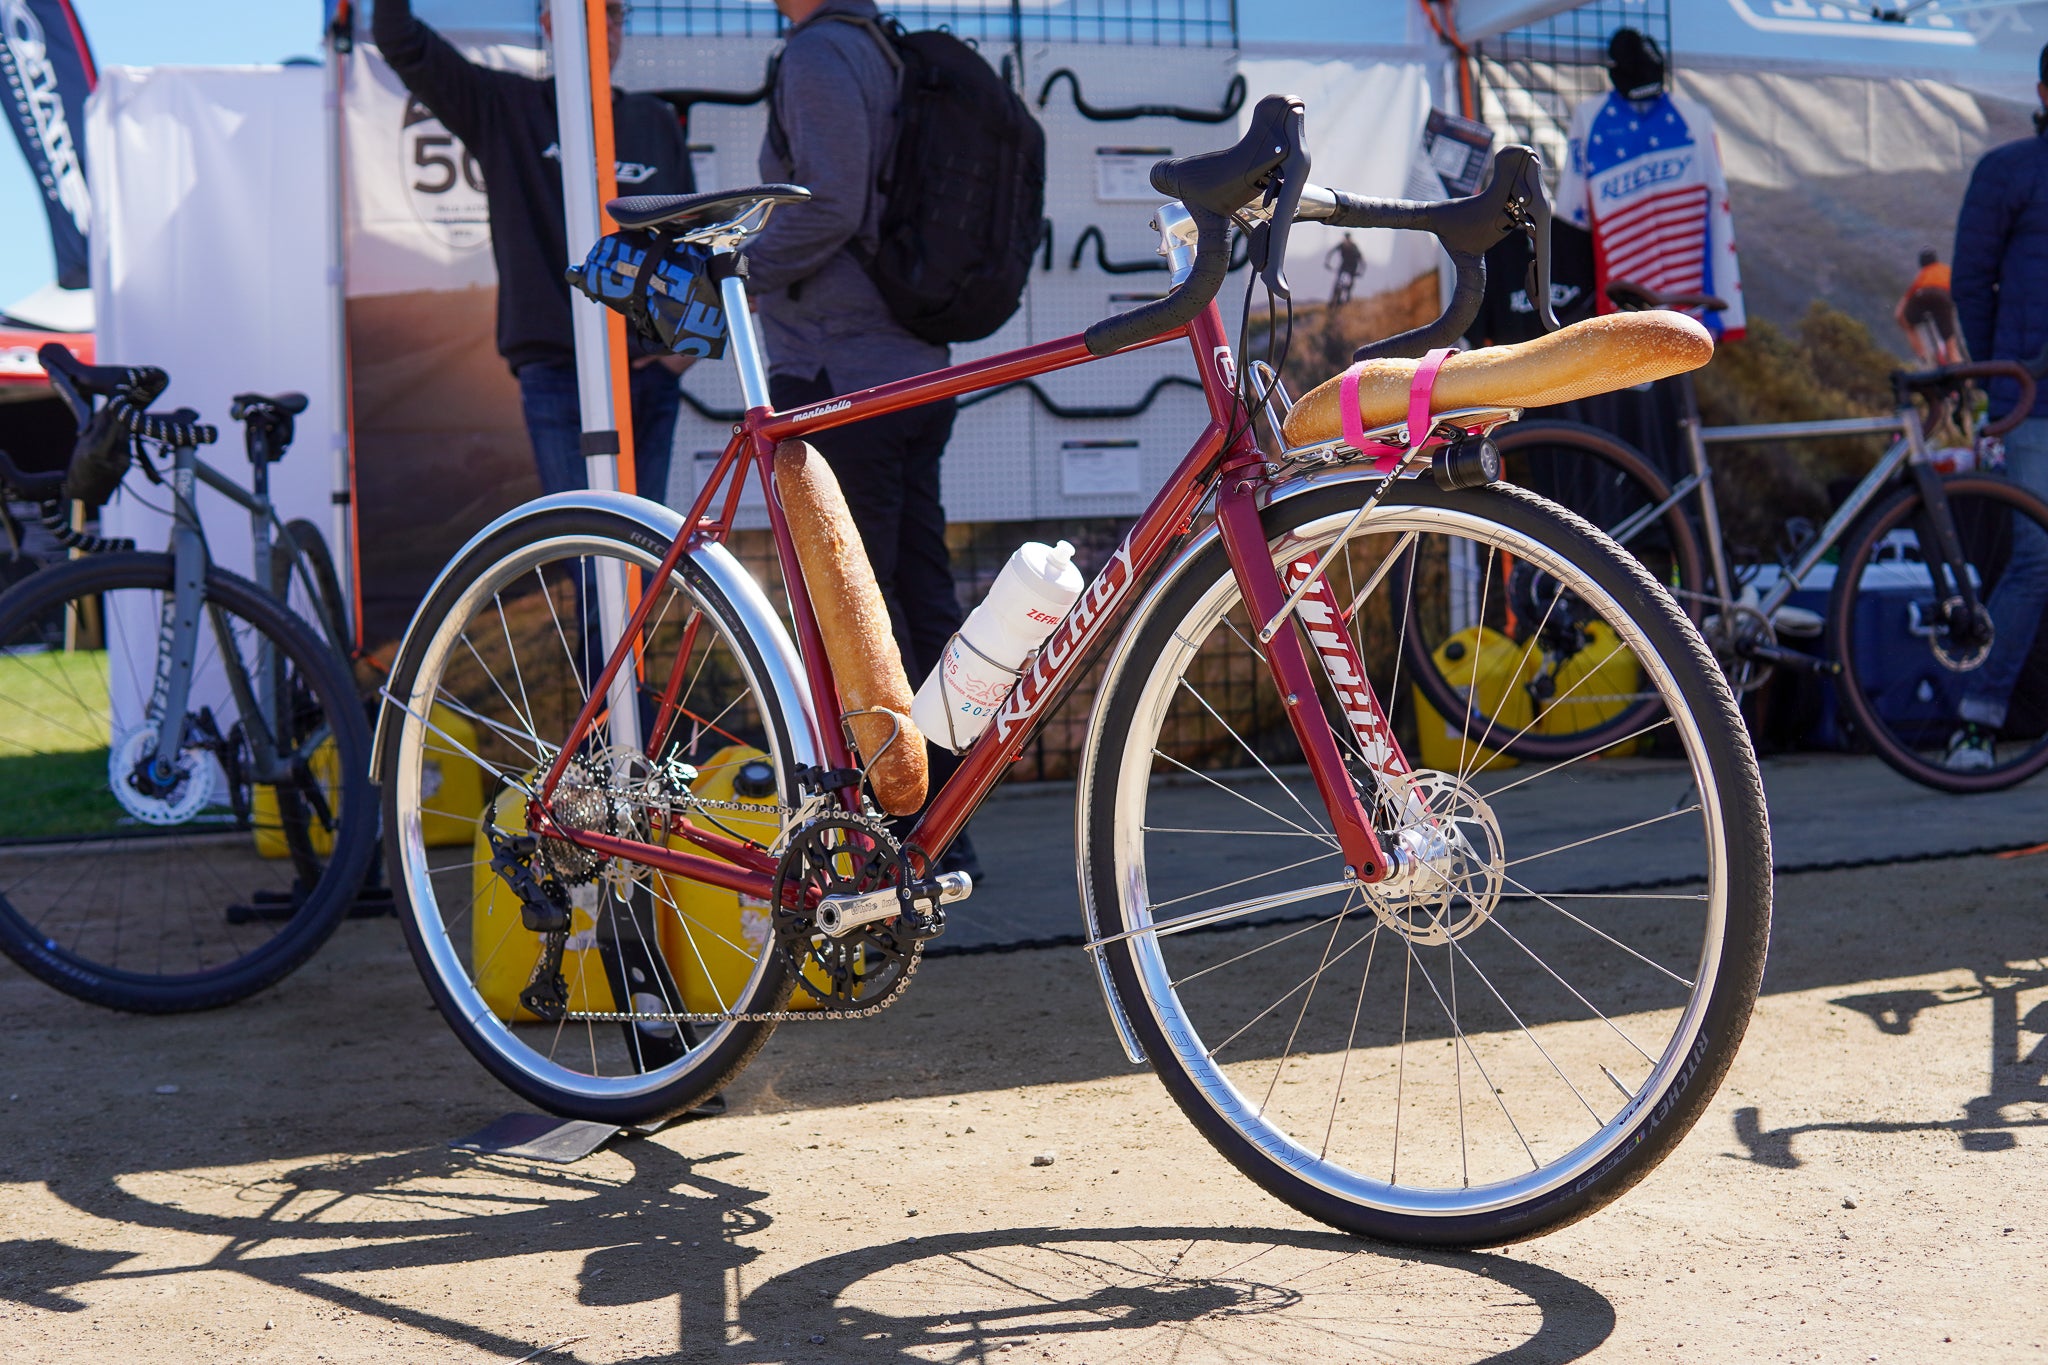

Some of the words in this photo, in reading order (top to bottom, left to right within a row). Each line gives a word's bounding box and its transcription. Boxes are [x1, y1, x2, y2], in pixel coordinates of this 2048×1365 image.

[792, 399, 852, 423] montebello
[1375, 464, 1404, 495] SOMA
[996, 522, 1137, 744] RITCHEY
[1026, 608, 1061, 626] ZEFAL
[1488, 529, 1683, 708] RITCHEY
[1147, 988, 1314, 1172] RITCHEY
[1650, 1031, 1710, 1135] RITCHEY
